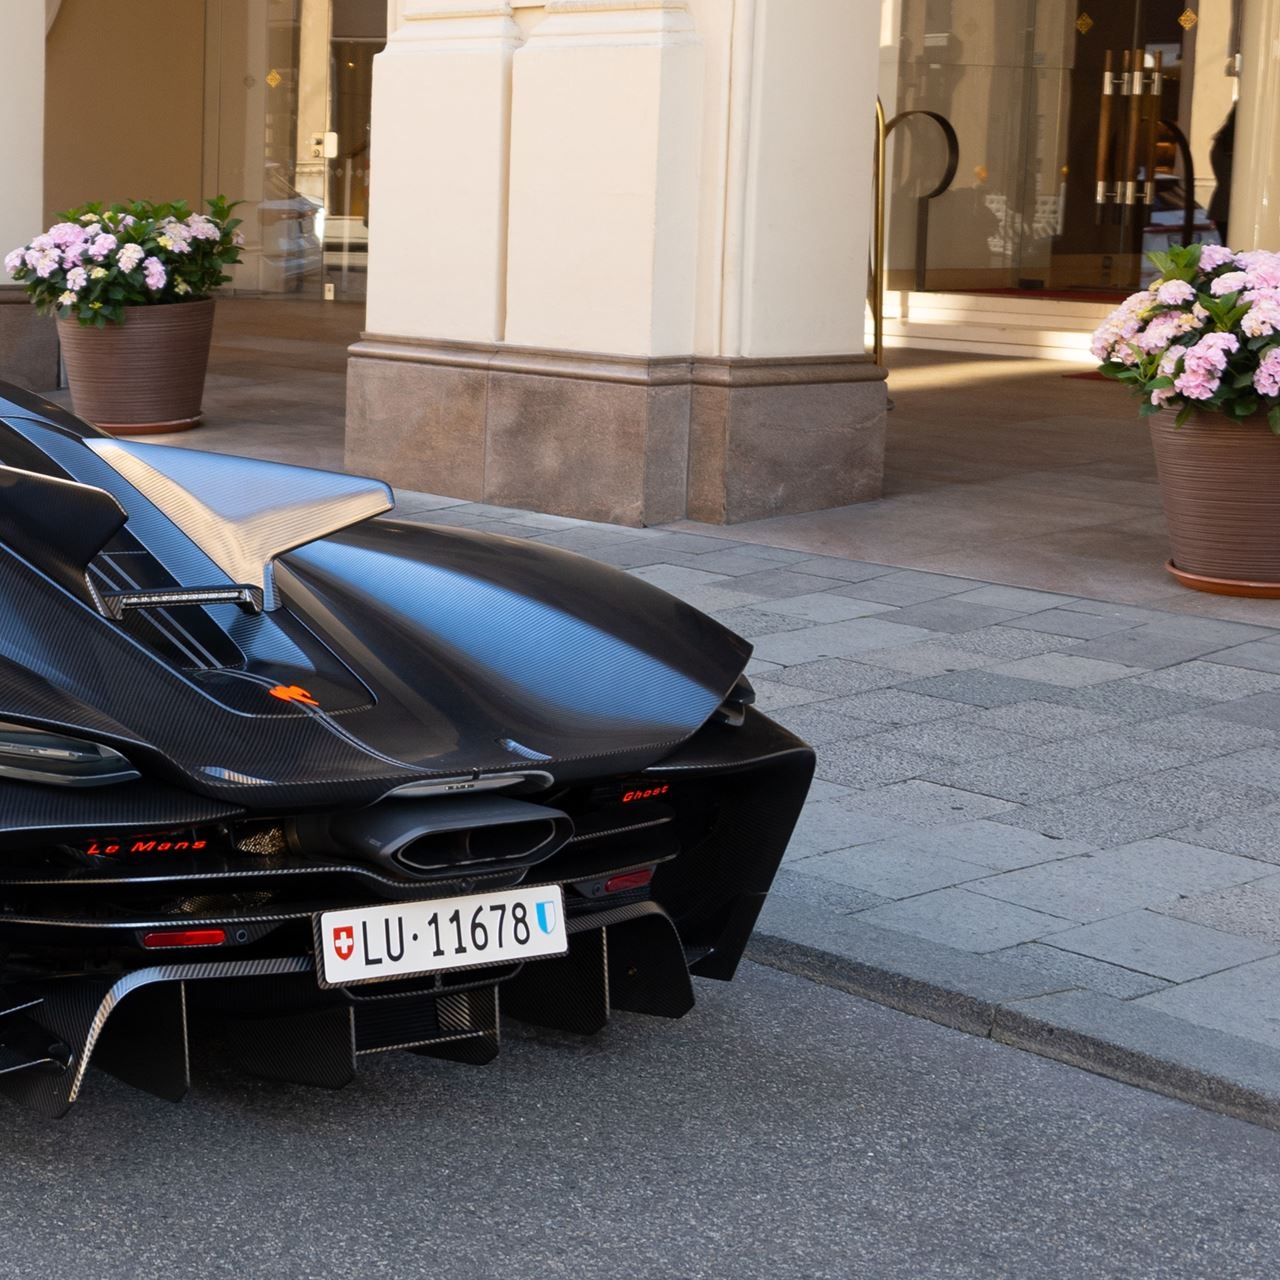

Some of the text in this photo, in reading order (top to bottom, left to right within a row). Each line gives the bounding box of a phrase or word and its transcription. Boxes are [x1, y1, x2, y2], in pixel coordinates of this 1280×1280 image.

[623, 785, 669, 803] Ghost
[87, 840, 207, 855] Le Mans
